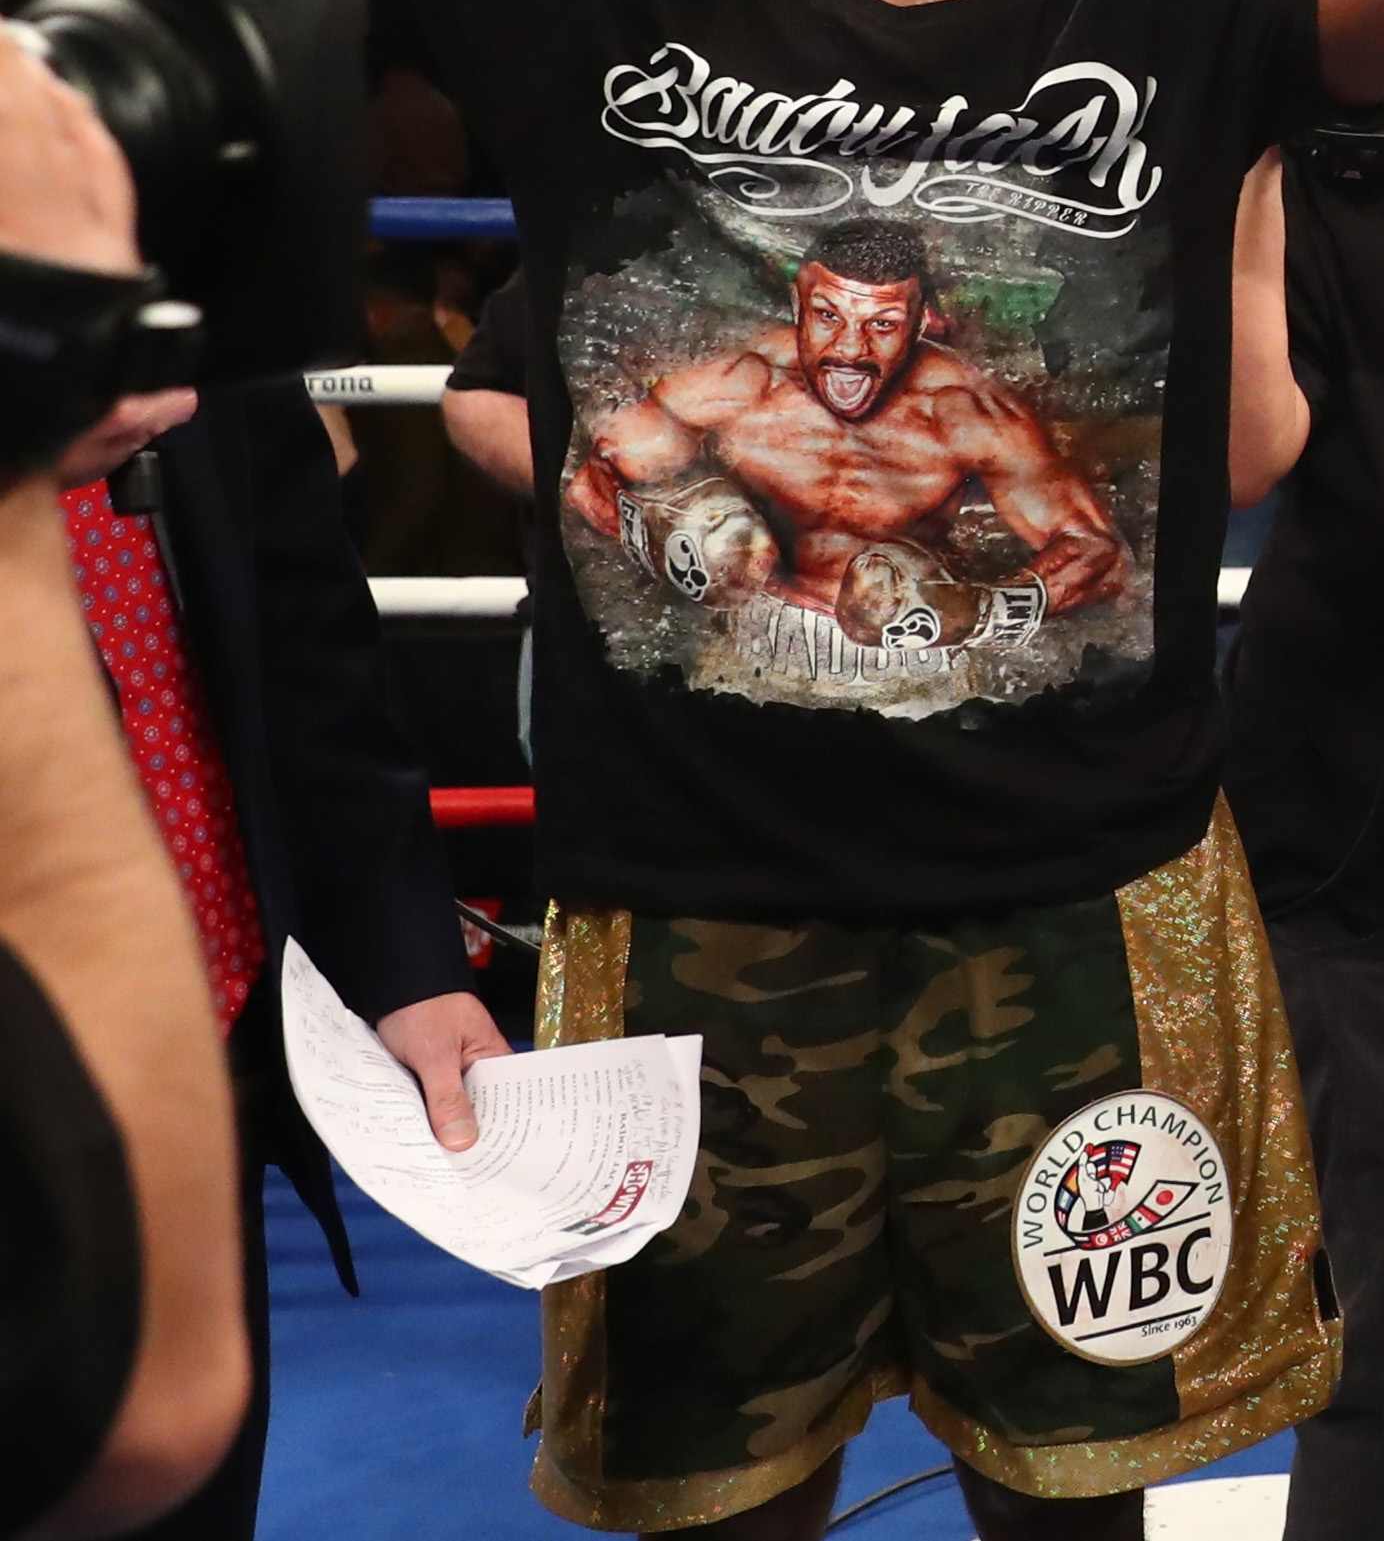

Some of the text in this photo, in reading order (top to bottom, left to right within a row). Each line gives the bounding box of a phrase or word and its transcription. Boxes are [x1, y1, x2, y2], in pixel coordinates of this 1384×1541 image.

[963, 182, 1088, 226] THE RIPPER
[308, 375, 374, 393] rona
[1023, 1104, 1224, 1249] WORLD CHAMPION
[1047, 1228, 1215, 1327] WBC
[1141, 1315, 1197, 1337] Since 1963
